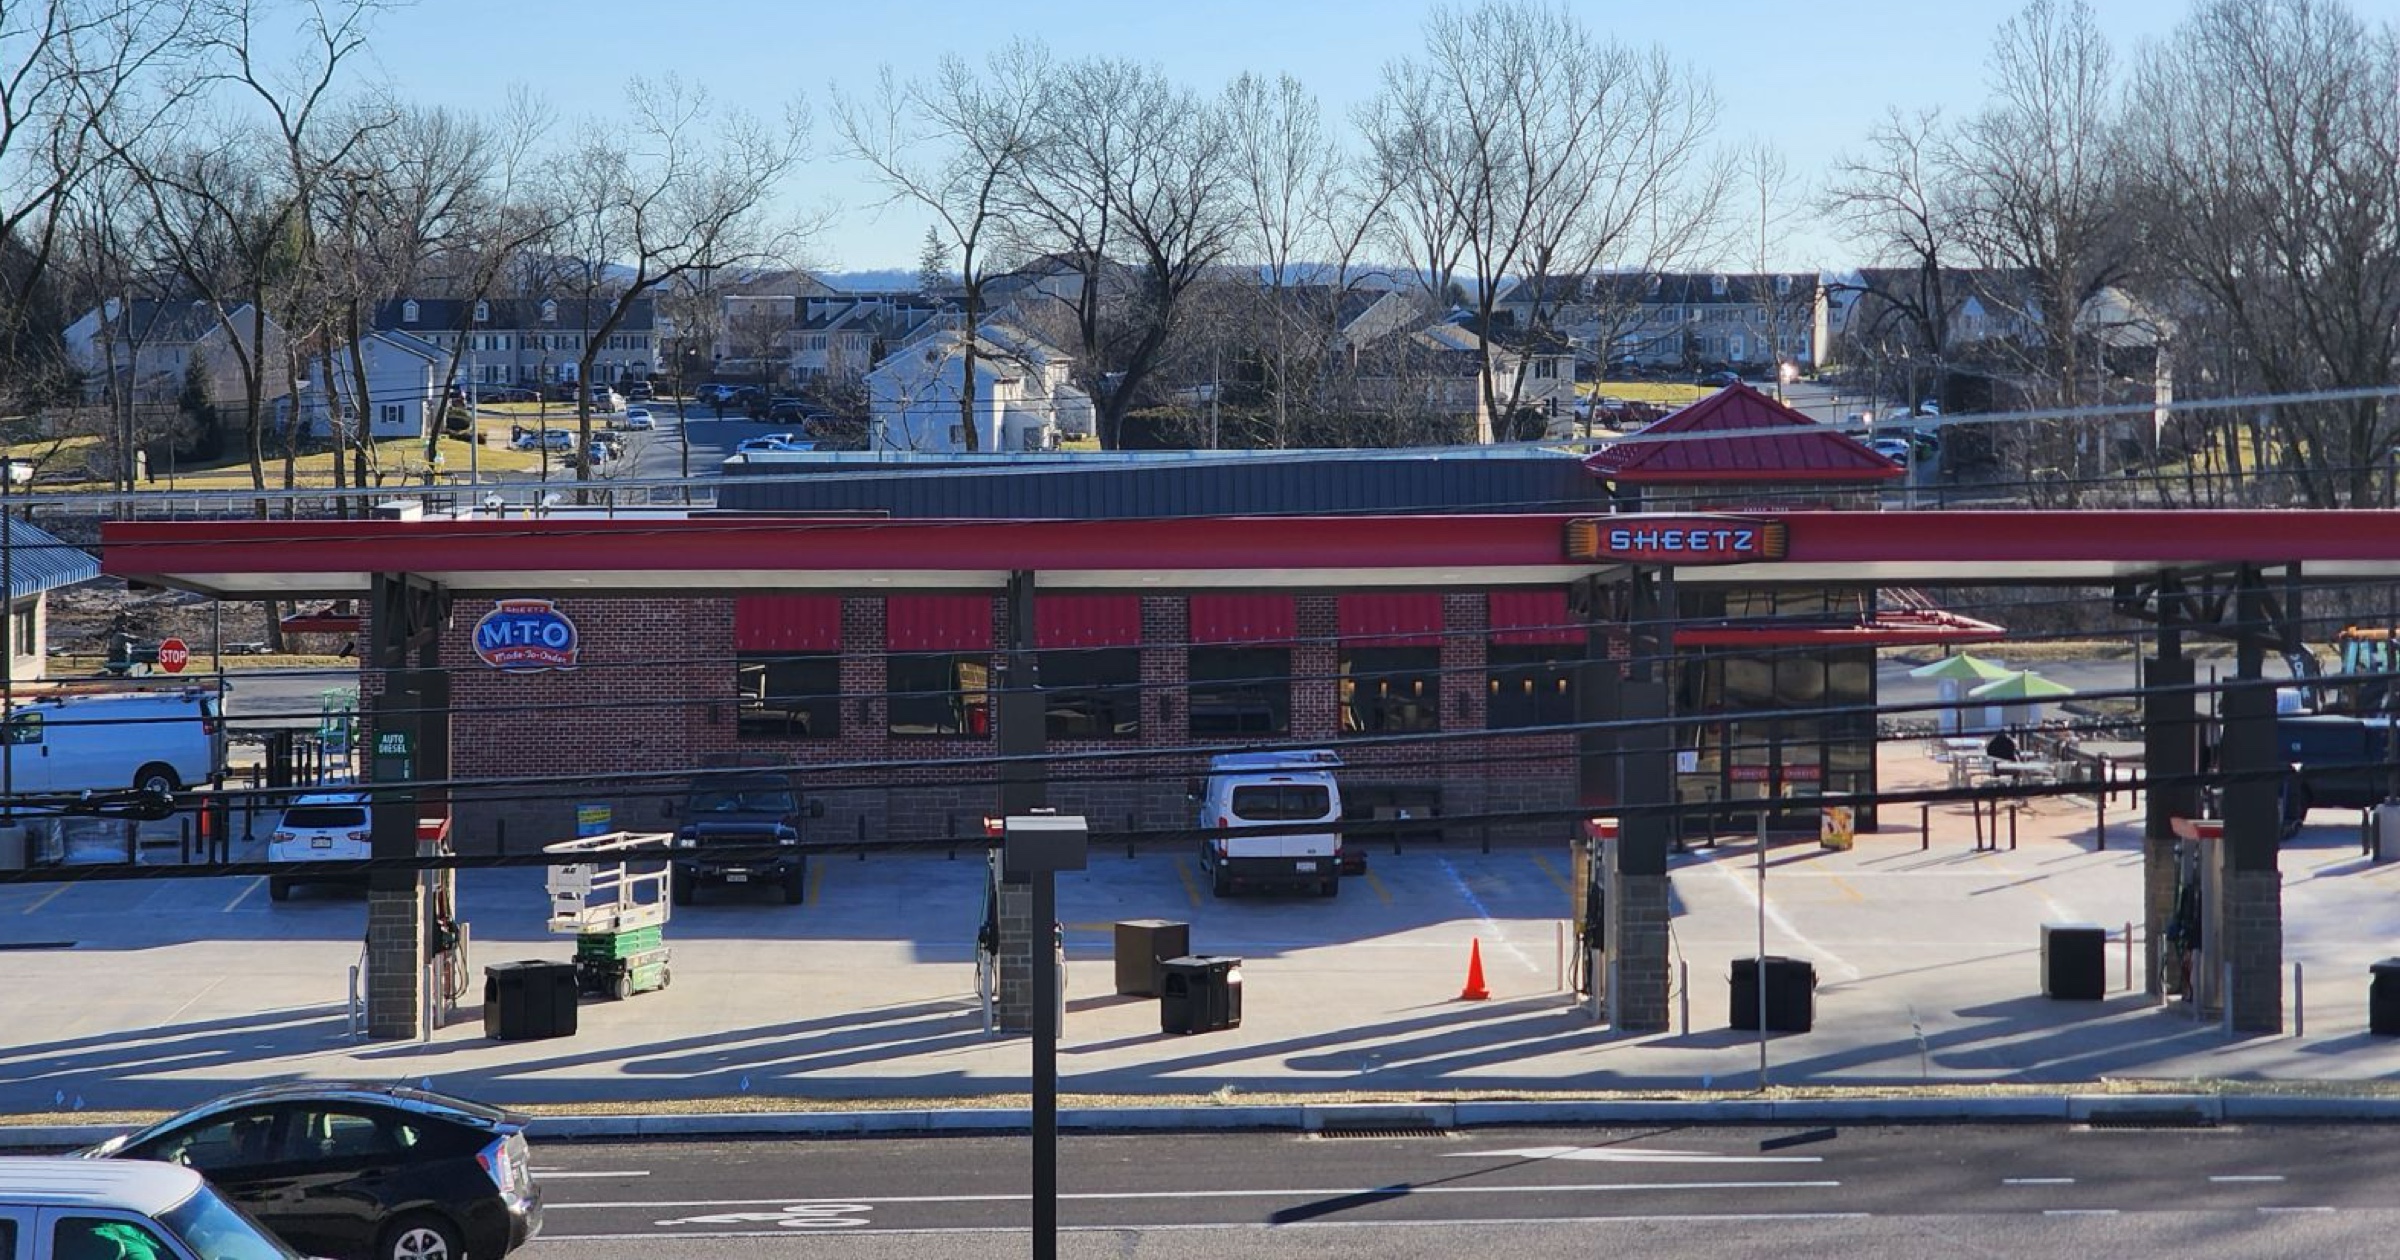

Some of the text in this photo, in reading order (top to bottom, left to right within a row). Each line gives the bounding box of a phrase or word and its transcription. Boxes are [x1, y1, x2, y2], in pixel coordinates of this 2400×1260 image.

[1611, 531, 1753, 549] SHEETZ
[161, 649, 186, 663] STOP
[382, 734, 404, 743] AUTO
[379, 743, 407, 753] DIESEL
